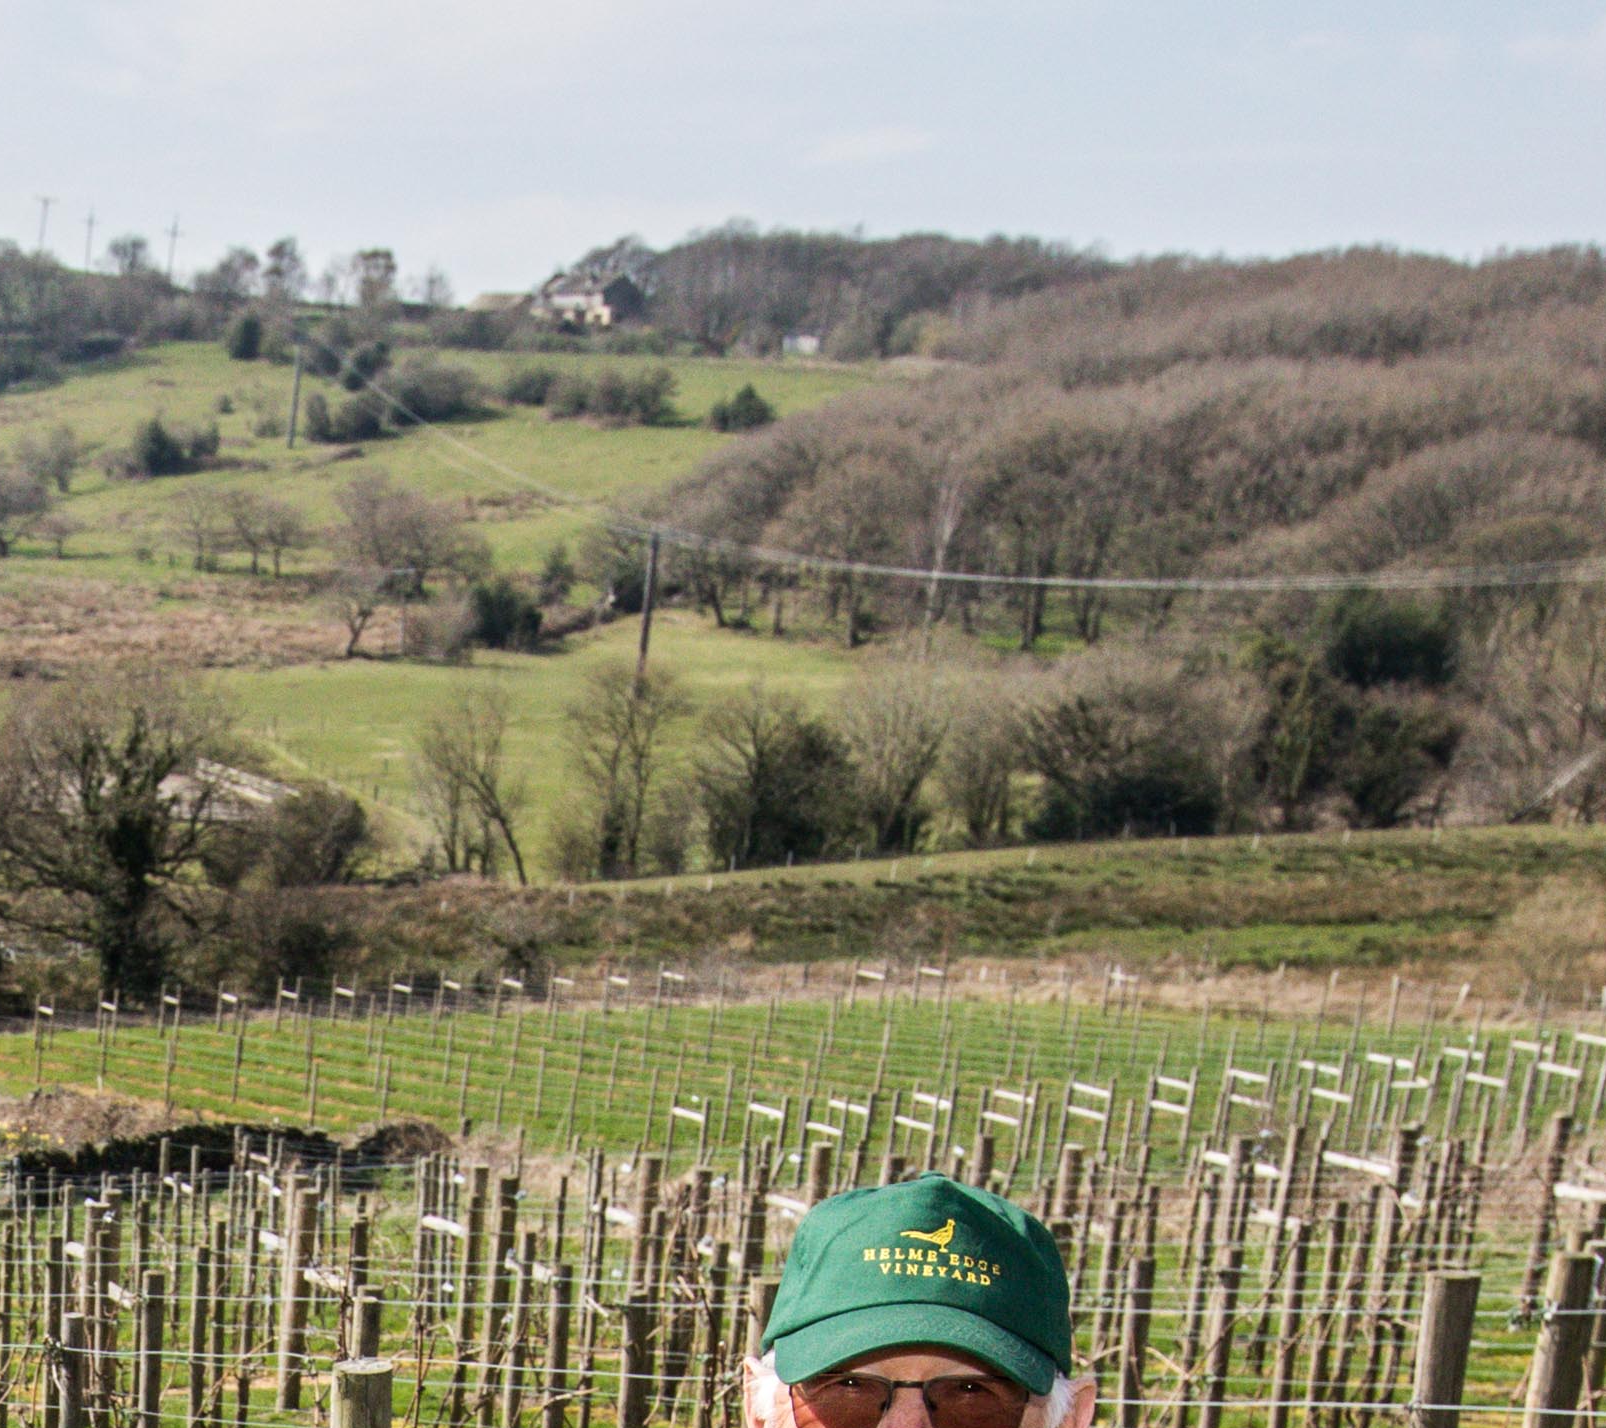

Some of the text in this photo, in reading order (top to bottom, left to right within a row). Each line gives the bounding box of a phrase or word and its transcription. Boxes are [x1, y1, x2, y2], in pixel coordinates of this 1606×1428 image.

[863, 1247, 1002, 1276] HELME EDGE
[879, 1263, 992, 1286] VINEYARD
